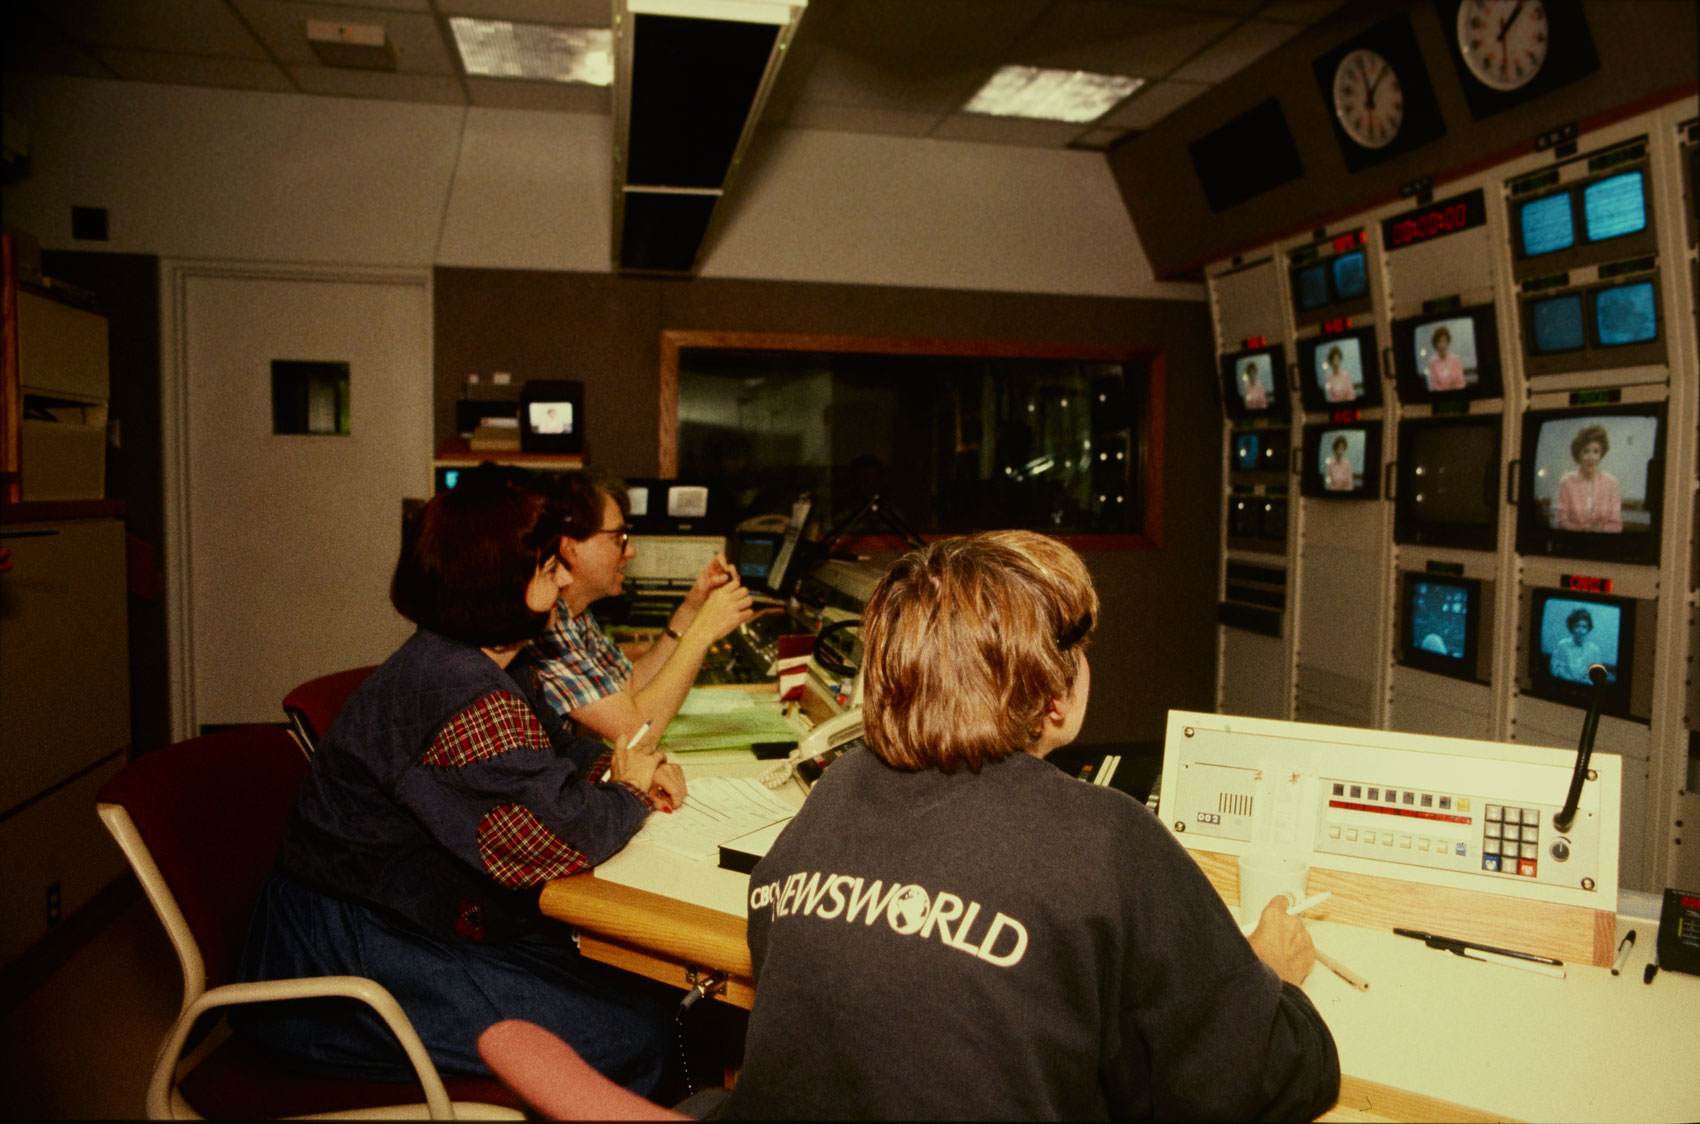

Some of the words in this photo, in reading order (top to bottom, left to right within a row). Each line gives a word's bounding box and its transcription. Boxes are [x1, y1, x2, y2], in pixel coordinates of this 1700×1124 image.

[1198, 813, 1219, 824] 002
[750, 882, 777, 910] CBC
[771, 871, 1029, 968] NEWSWORLD
